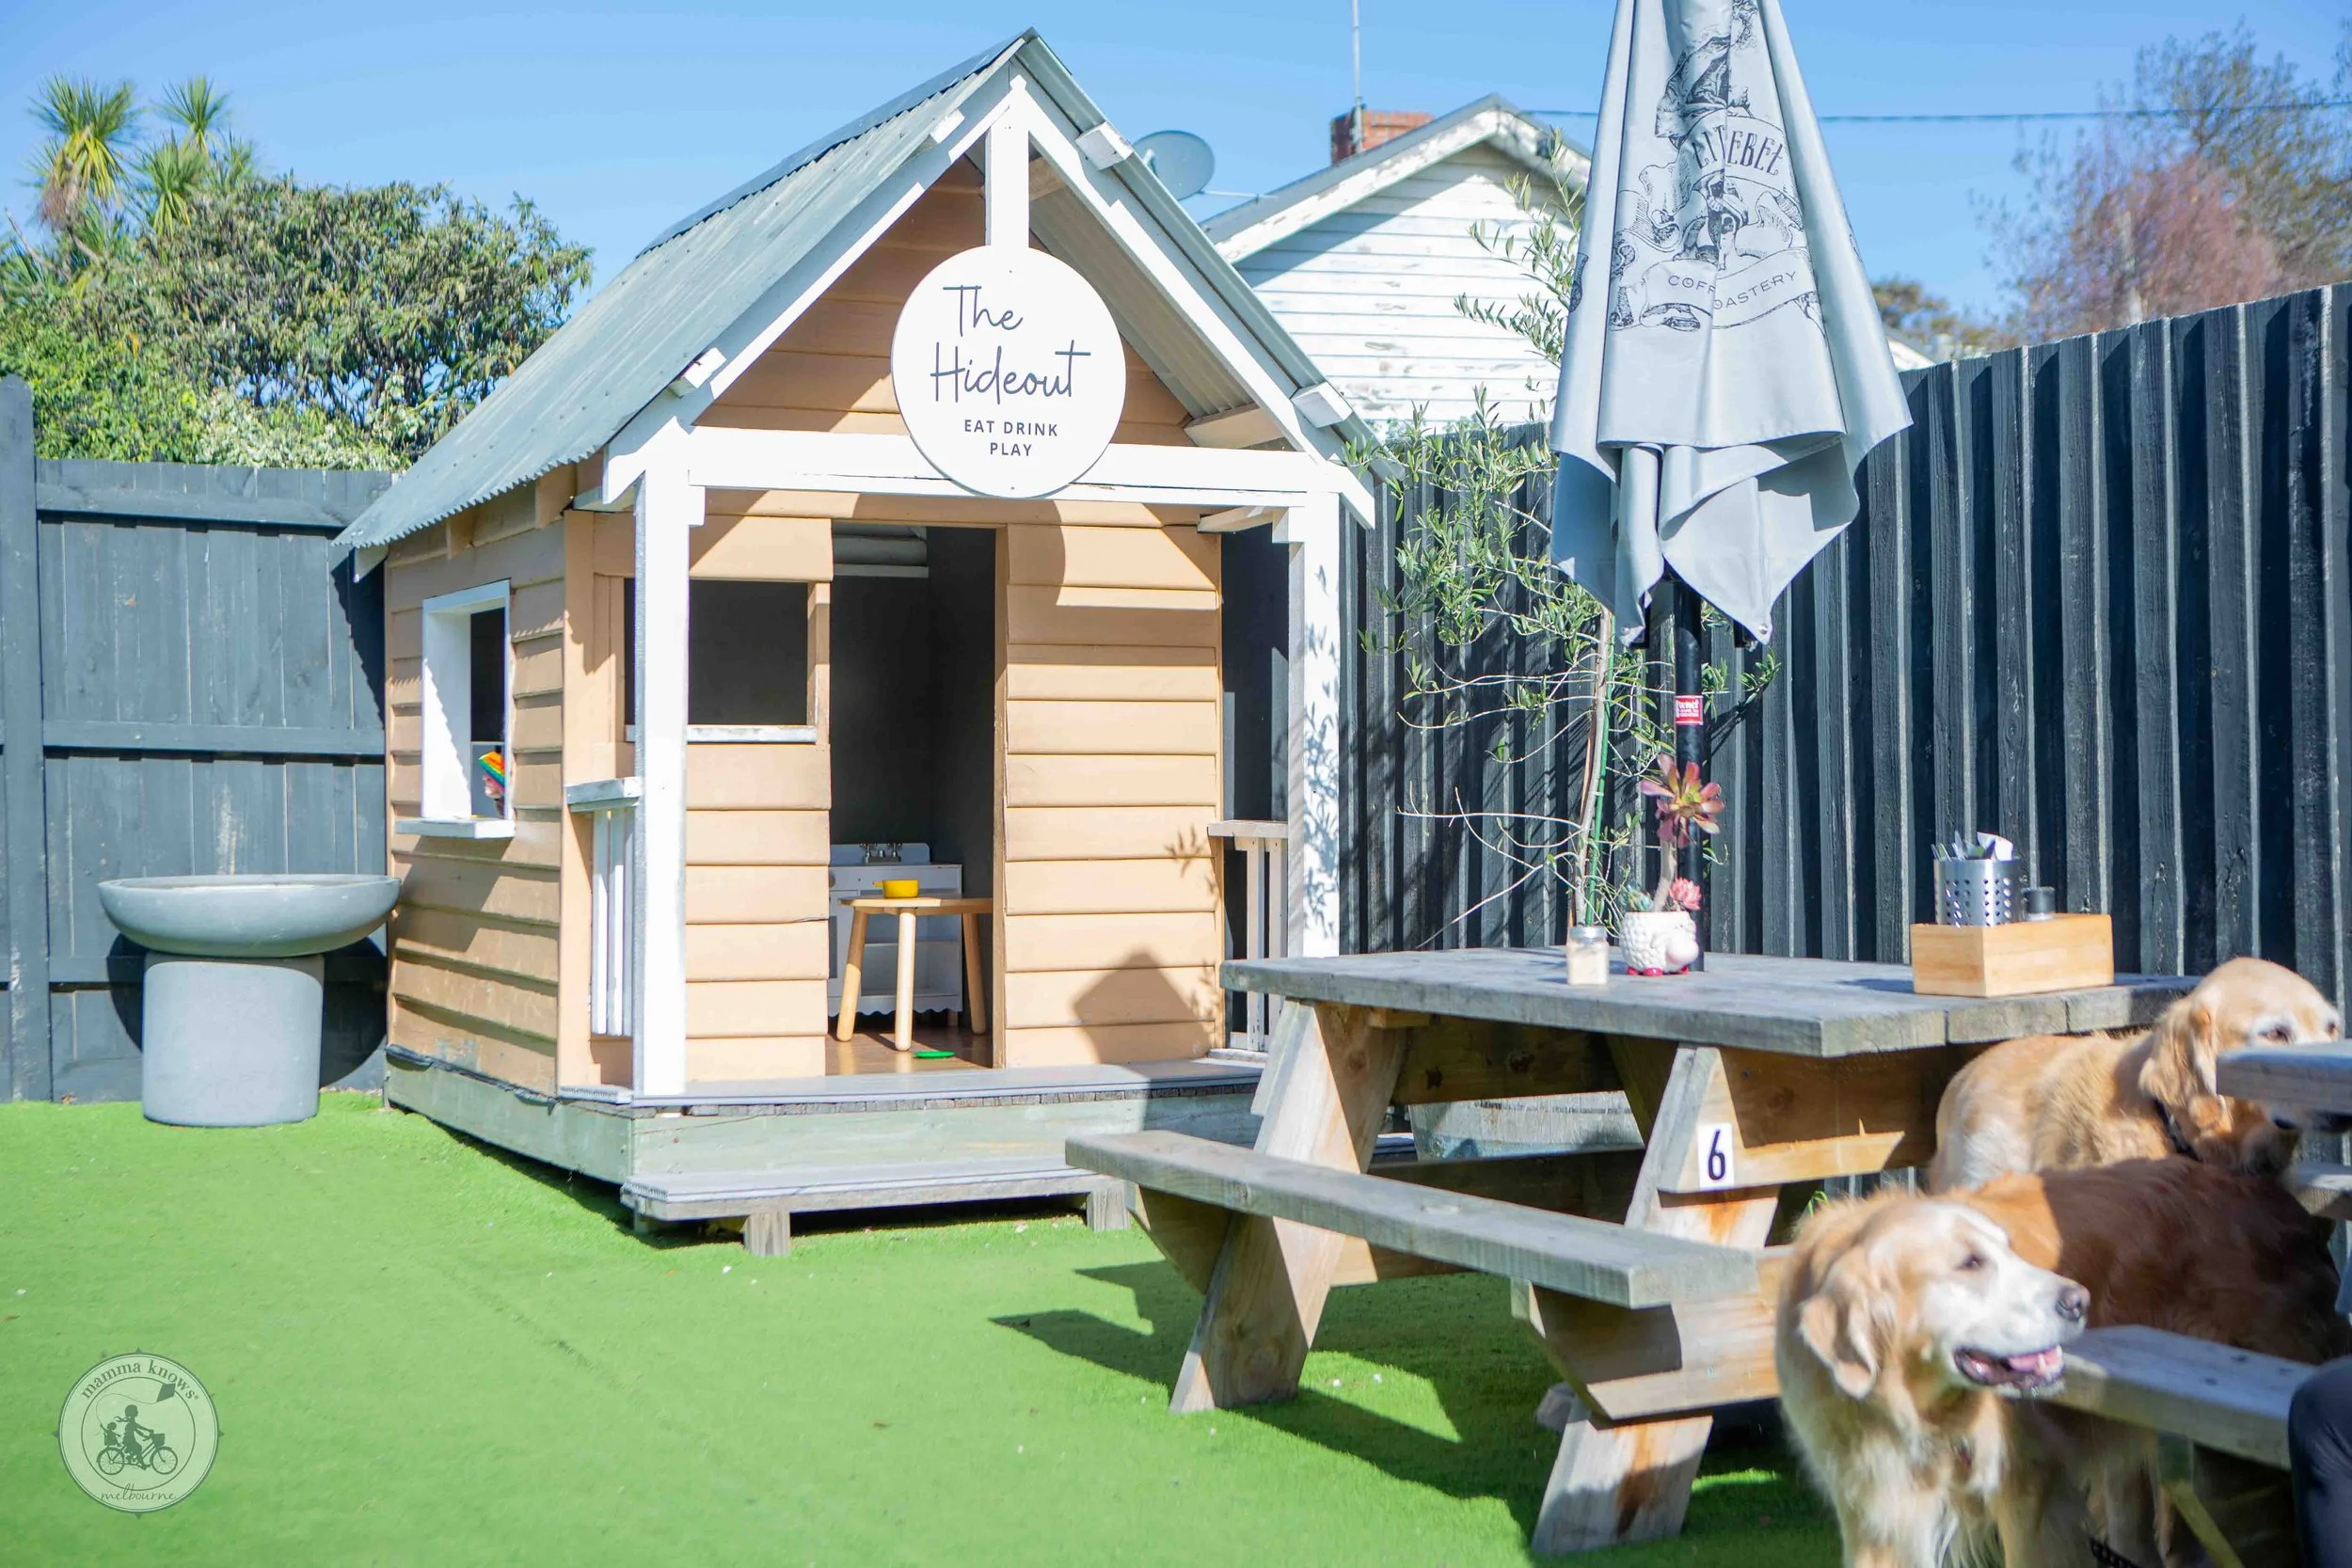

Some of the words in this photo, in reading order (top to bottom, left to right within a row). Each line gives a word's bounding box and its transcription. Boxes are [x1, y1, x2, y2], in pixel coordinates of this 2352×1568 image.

[943, 284, 1024, 337] The
[1668, 275, 1716, 294] COFF
[1714, 271, 1796, 309] OASTERY
[930, 340, 1091, 404] Hideout
[964, 419, 994, 434] EAT
[1004, 421, 1058, 436] DRINK
[990, 442, 1032, 456] PLAY
[1708, 1129, 1726, 1180] 6
